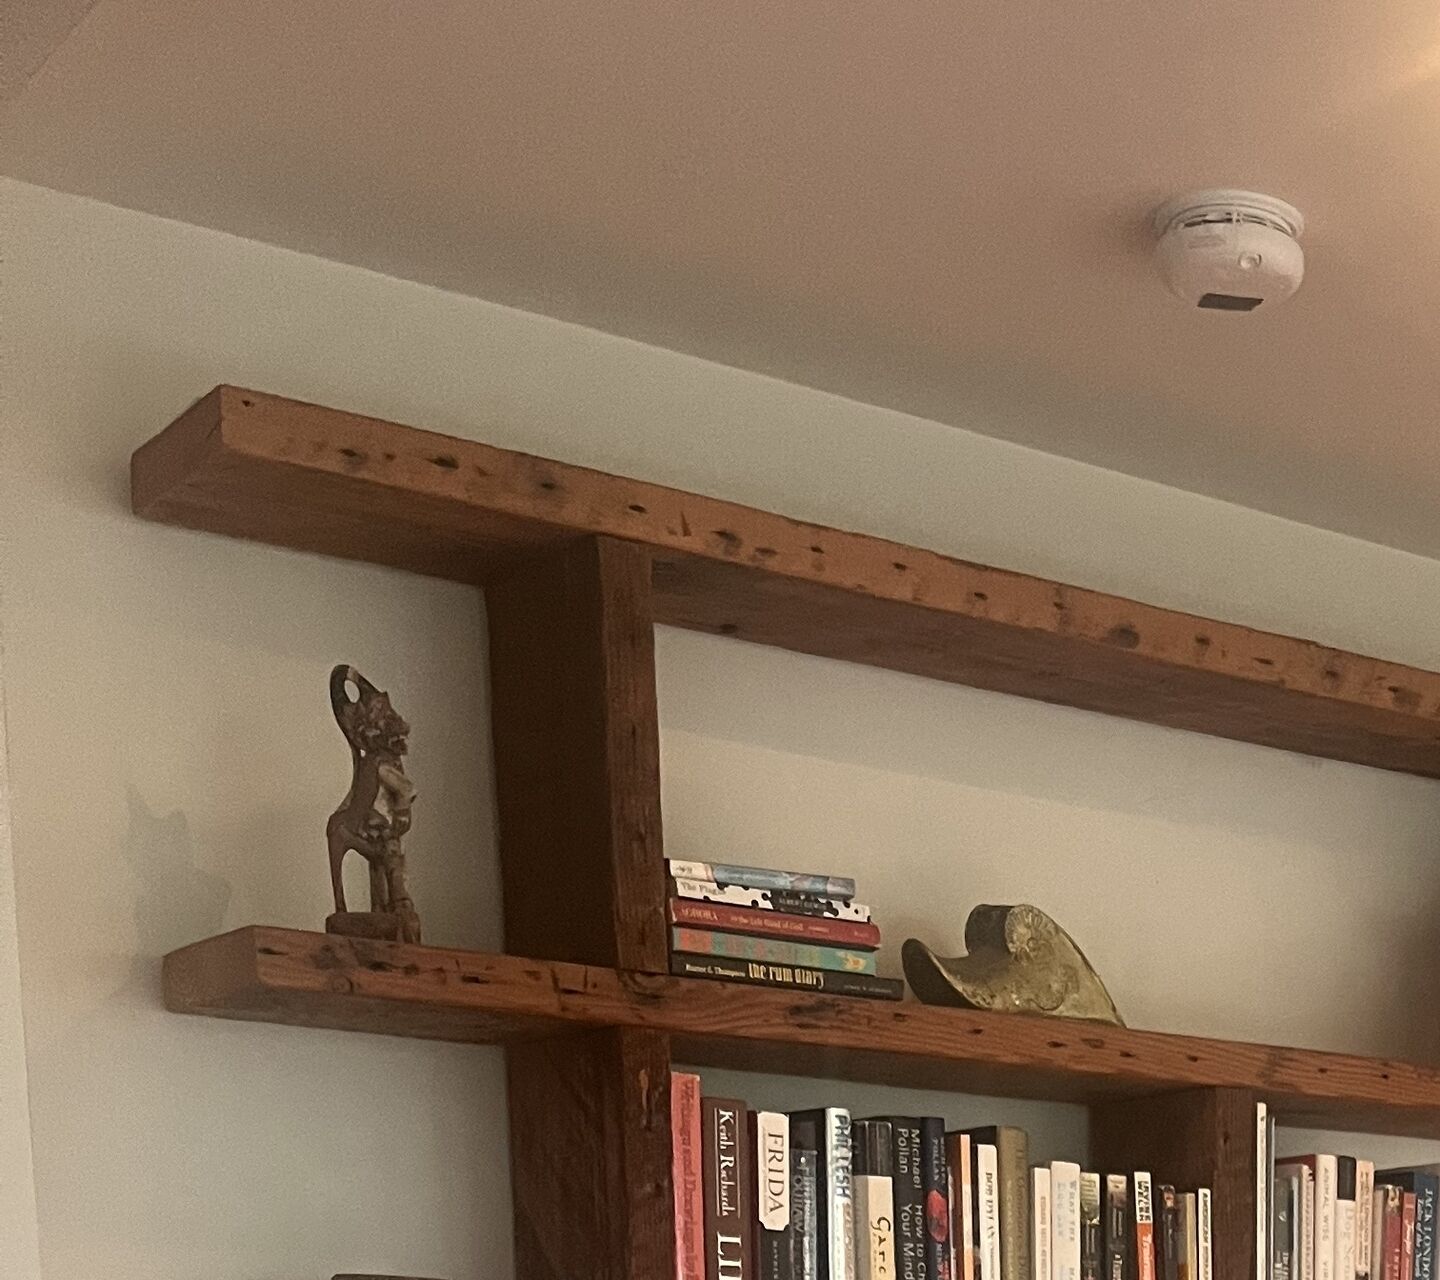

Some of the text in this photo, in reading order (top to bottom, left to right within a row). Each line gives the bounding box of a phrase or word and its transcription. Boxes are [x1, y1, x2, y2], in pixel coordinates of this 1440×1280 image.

[748, 963, 767, 980] the
[769, 966, 794, 982] rum
[794, 968, 825, 989] diary
[719, 1109, 736, 1216] Keith Richards
[767, 1131, 784, 1213] FRIDA
[898, 1128, 909, 1174] Pollan
[911, 1128, 922, 1189] Michael
[835, 1155, 852, 1199] LESH
[1322, 1167, 1330, 1211] ANIMAL
[914, 1204, 923, 1238] How
[1144, 1180, 1152, 1222] IRVINE
[1422, 1188, 1434, 1223] JACK
[901, 1203, 915, 1280] Your Mind
[916, 1243, 924, 1258] to
